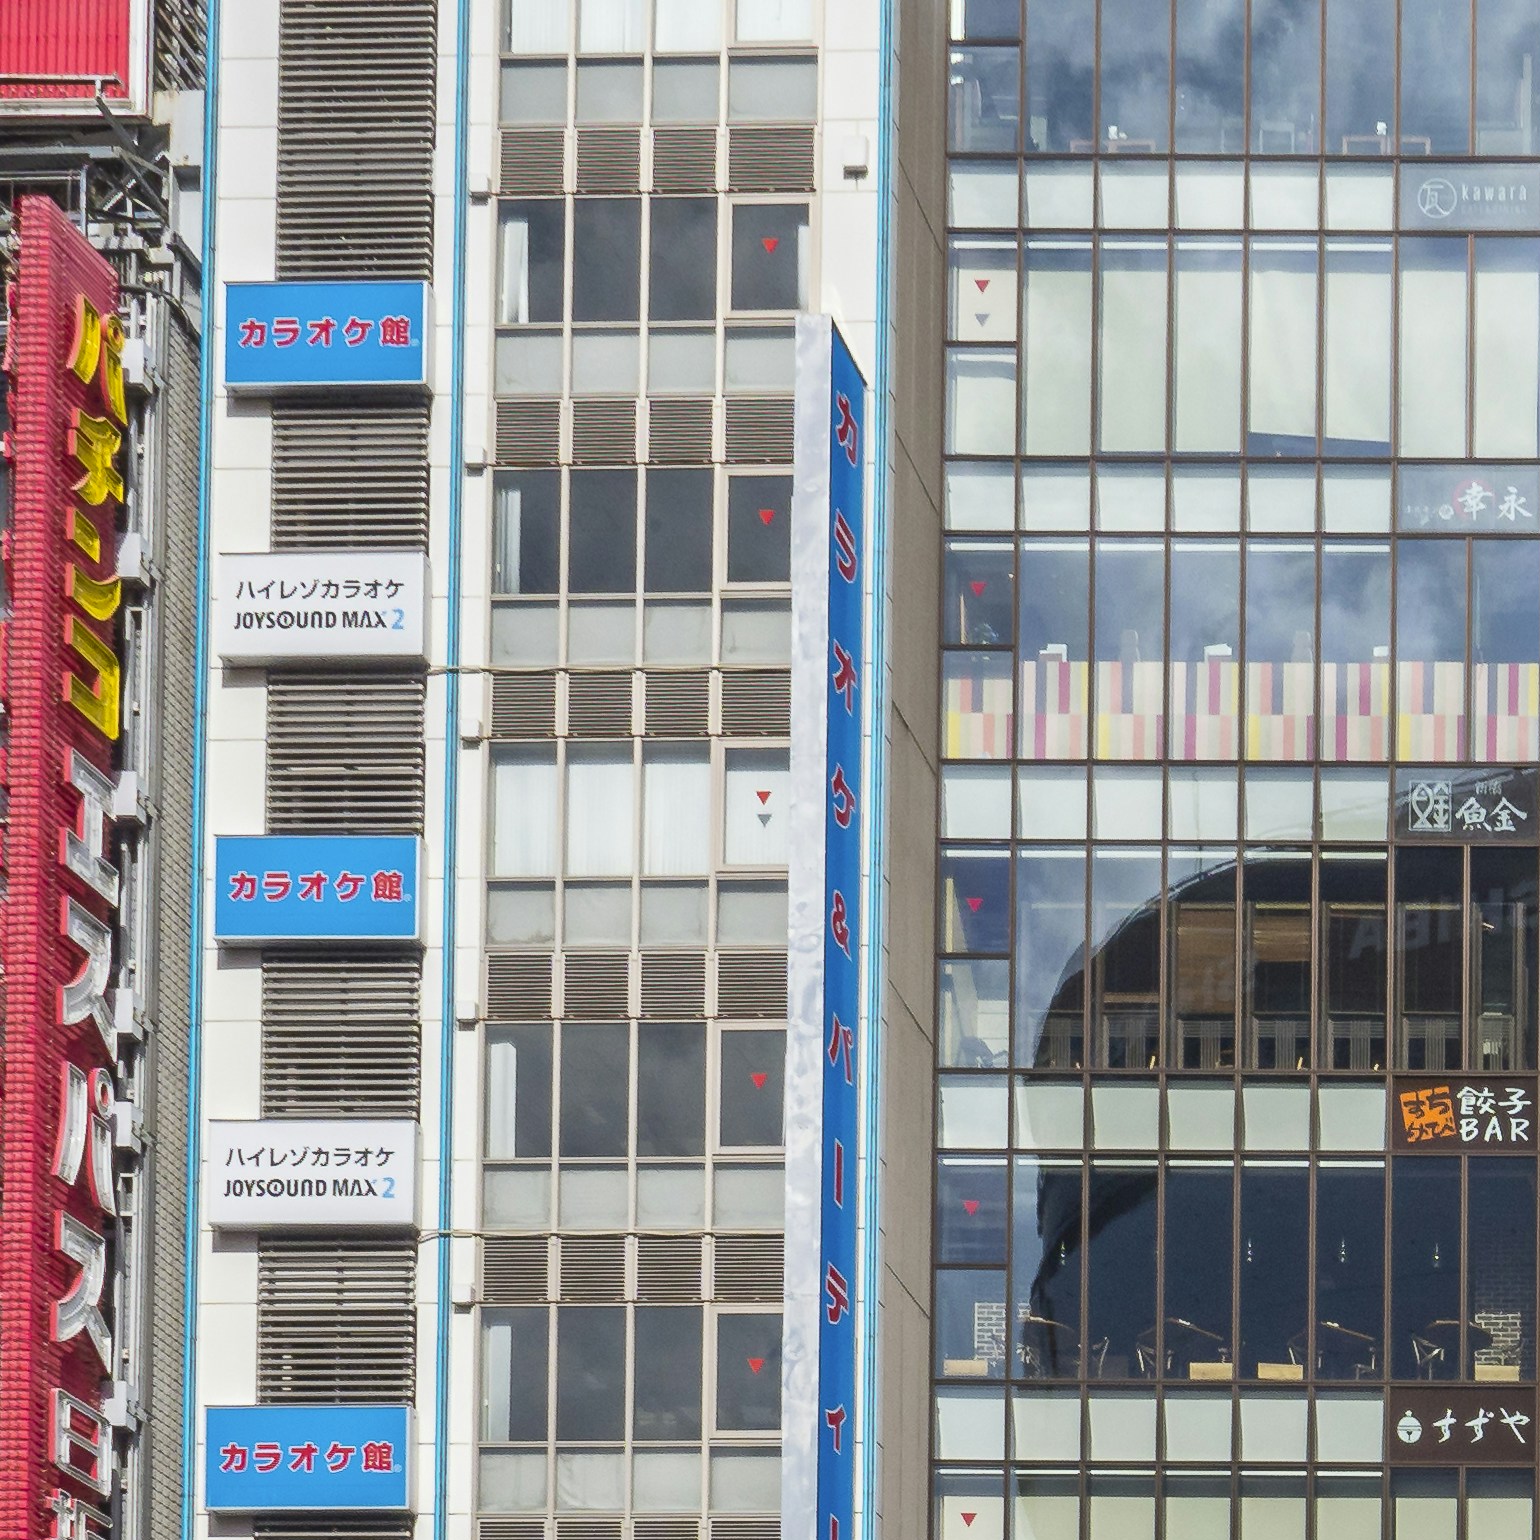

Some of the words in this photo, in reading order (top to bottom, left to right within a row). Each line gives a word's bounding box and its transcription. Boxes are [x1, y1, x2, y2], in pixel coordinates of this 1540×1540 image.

[239, 317, 411, 348] カラオケ館
[236, 578, 405, 600] ハイレゾカラオケ
[233, 610, 338, 631] JOYSOUND
[1456, 796, 1529, 832] 魚金
[229, 871, 403, 902] カラオケ館
[1457, 1086, 1532, 1116] 餃子
[1458, 1116, 1531, 1142] BAR
[226, 1146, 395, 1168] ハイレゾカラオケ
[224, 1177, 327, 1198] JOYSOUND
[220, 1442, 394, 1473] カラオケ館
